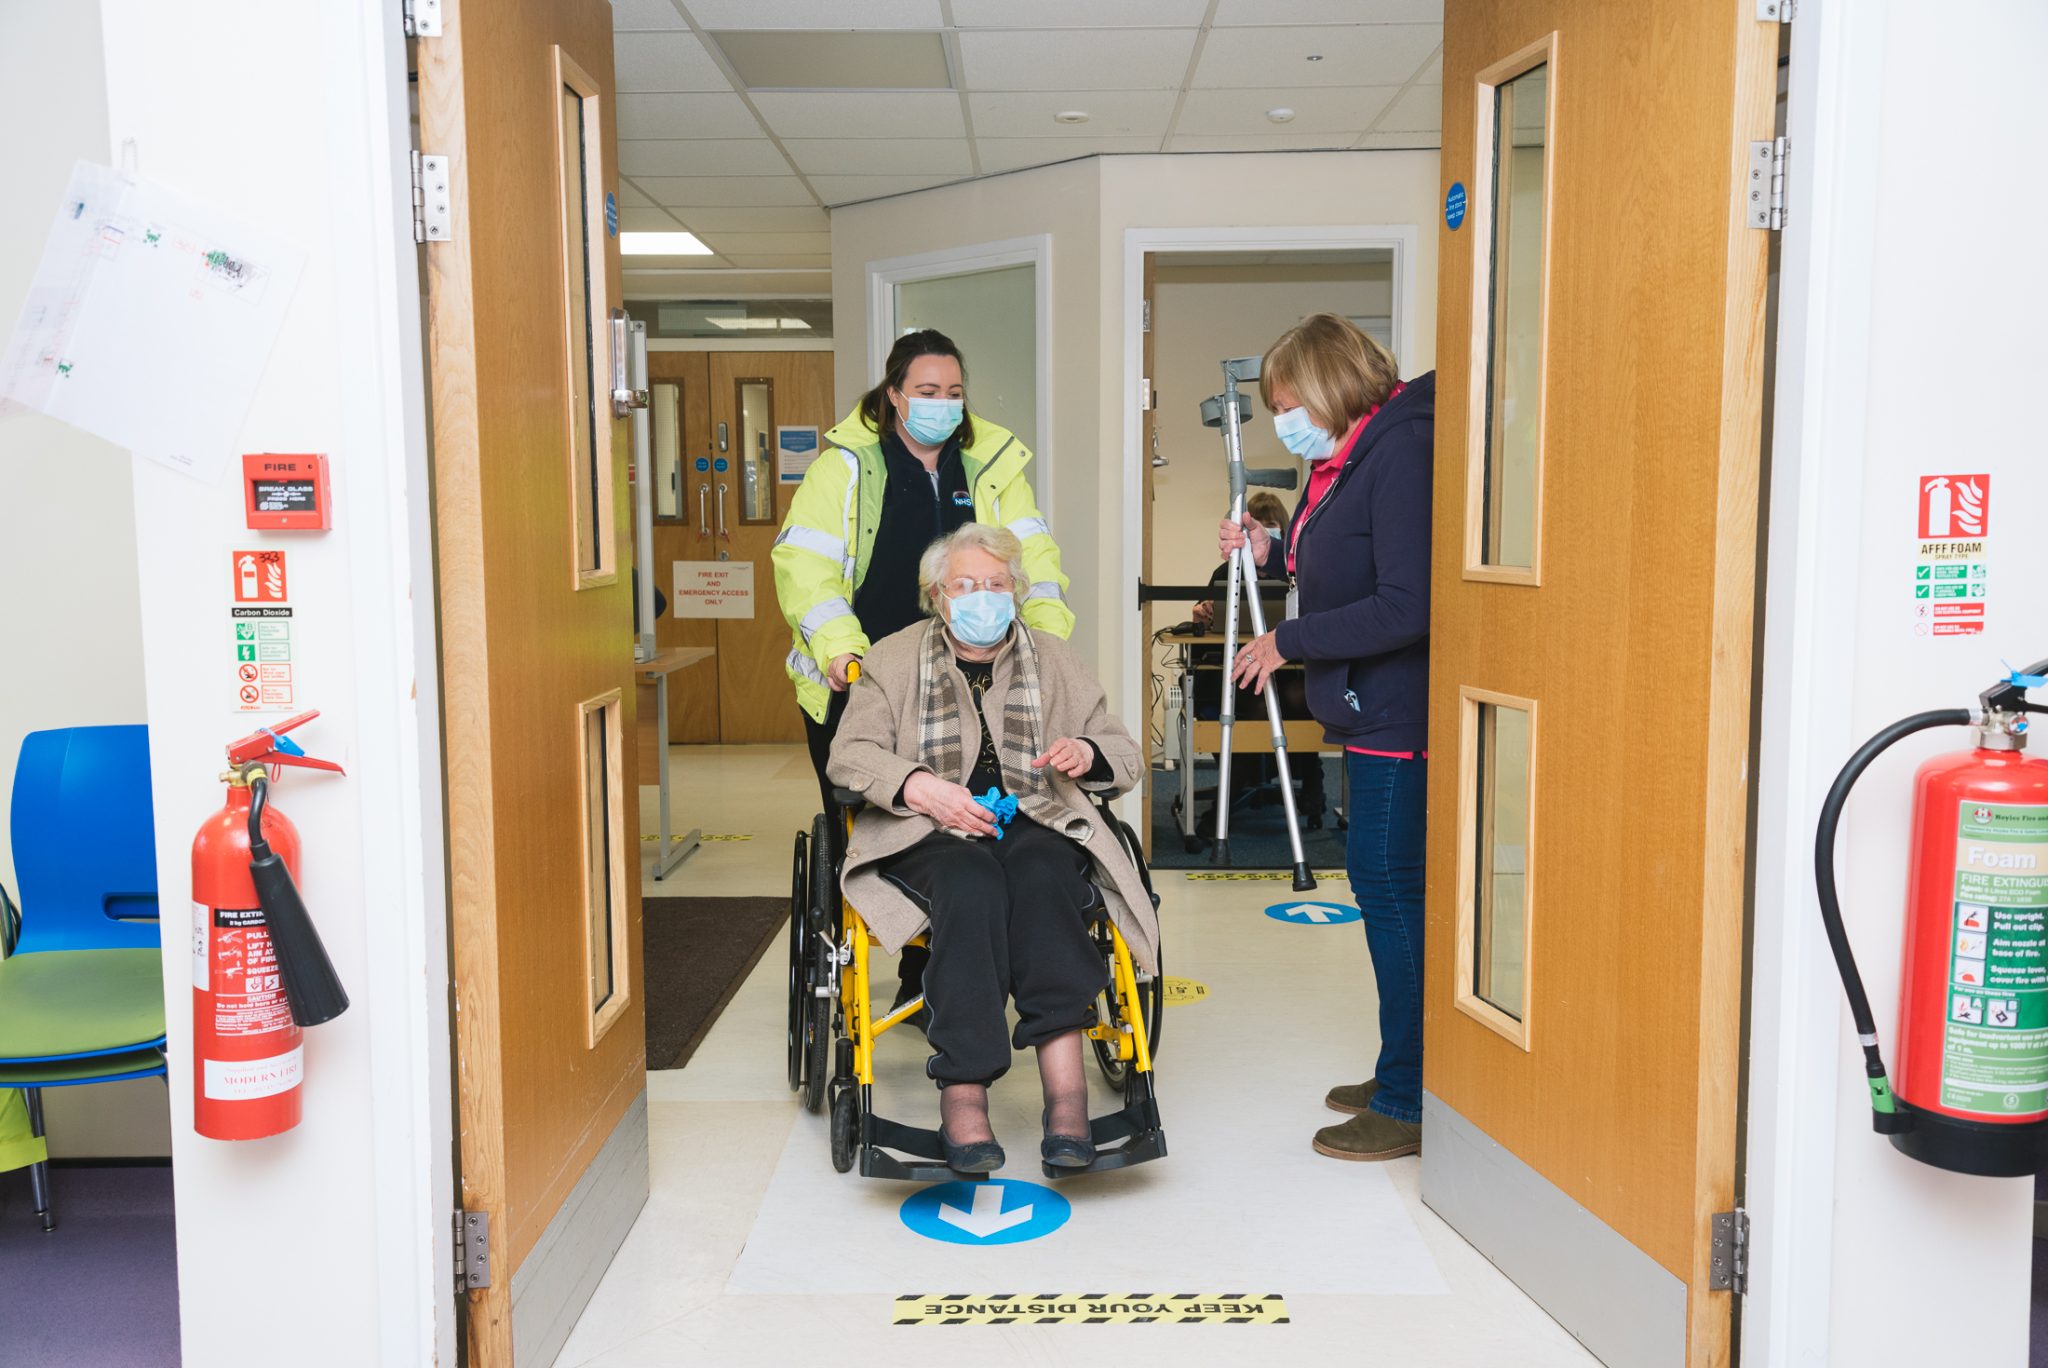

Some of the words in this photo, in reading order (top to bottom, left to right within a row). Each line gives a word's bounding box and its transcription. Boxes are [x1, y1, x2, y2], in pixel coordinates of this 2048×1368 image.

[1922, 544, 1947, 554] AFFF
[1951, 542, 1982, 554] FOAM
[1968, 846, 2036, 868] Foam
[1962, 873, 1989, 886] FIRE
[2014, 913, 2044, 921] upright.
[1994, 922, 2012, 930] Pull
[2028, 923, 2044, 932] clip.
[246, 932, 269, 940] PULL
[1992, 949, 2013, 957] base
[1991, 965, 2026, 974] Squeeze
[248, 993, 276, 1002] CAUTION
[1972, 998, 1982, 1008] A
[2008, 1000, 2018, 1010] B
[1949, 1028, 1966, 1036] Safe
[925, 1304, 1077, 1314] DISTANCE
[1088, 1304, 1174, 1314] YOUR
[1184, 1304, 1264, 1314] KEEP
